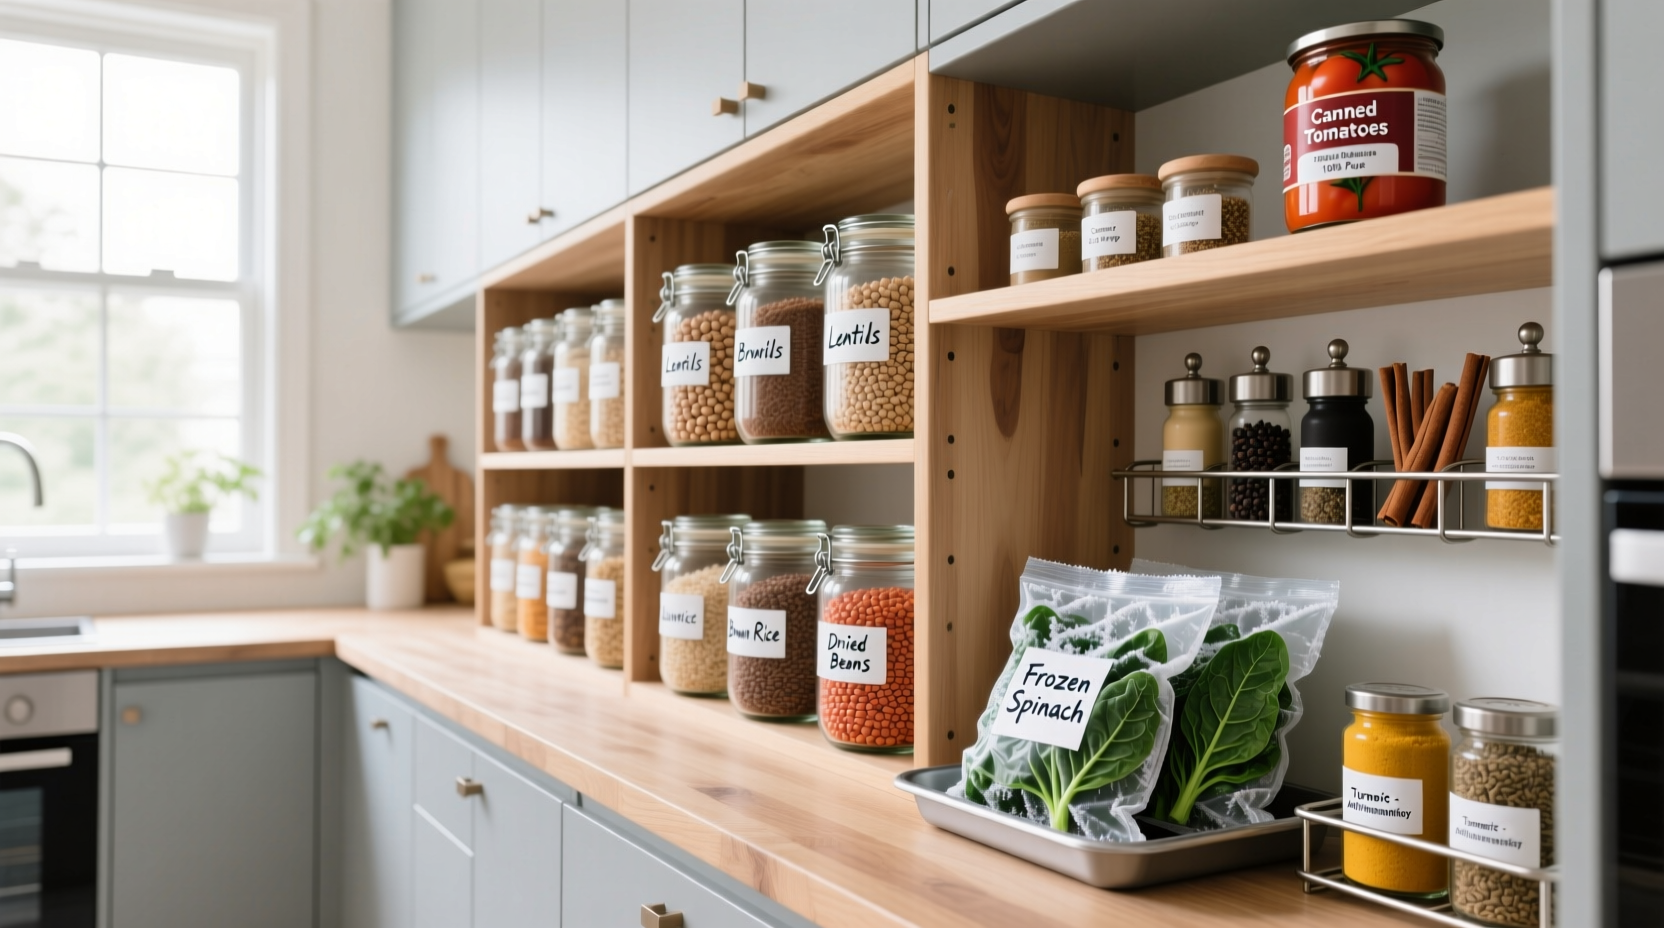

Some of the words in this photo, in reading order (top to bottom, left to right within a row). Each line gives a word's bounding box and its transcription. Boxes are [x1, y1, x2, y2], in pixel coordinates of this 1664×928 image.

[1311, 100, 1377, 124] Canned
[1304, 122, 1388, 144] Tomatoes
[829, 321, 880, 349] Lentils
[754, 621, 780, 642] Rice
[830, 652, 871, 672] Beans
[1022, 663, 1090, 693] Frozen
[1006, 689, 1084, 724] Spinach
